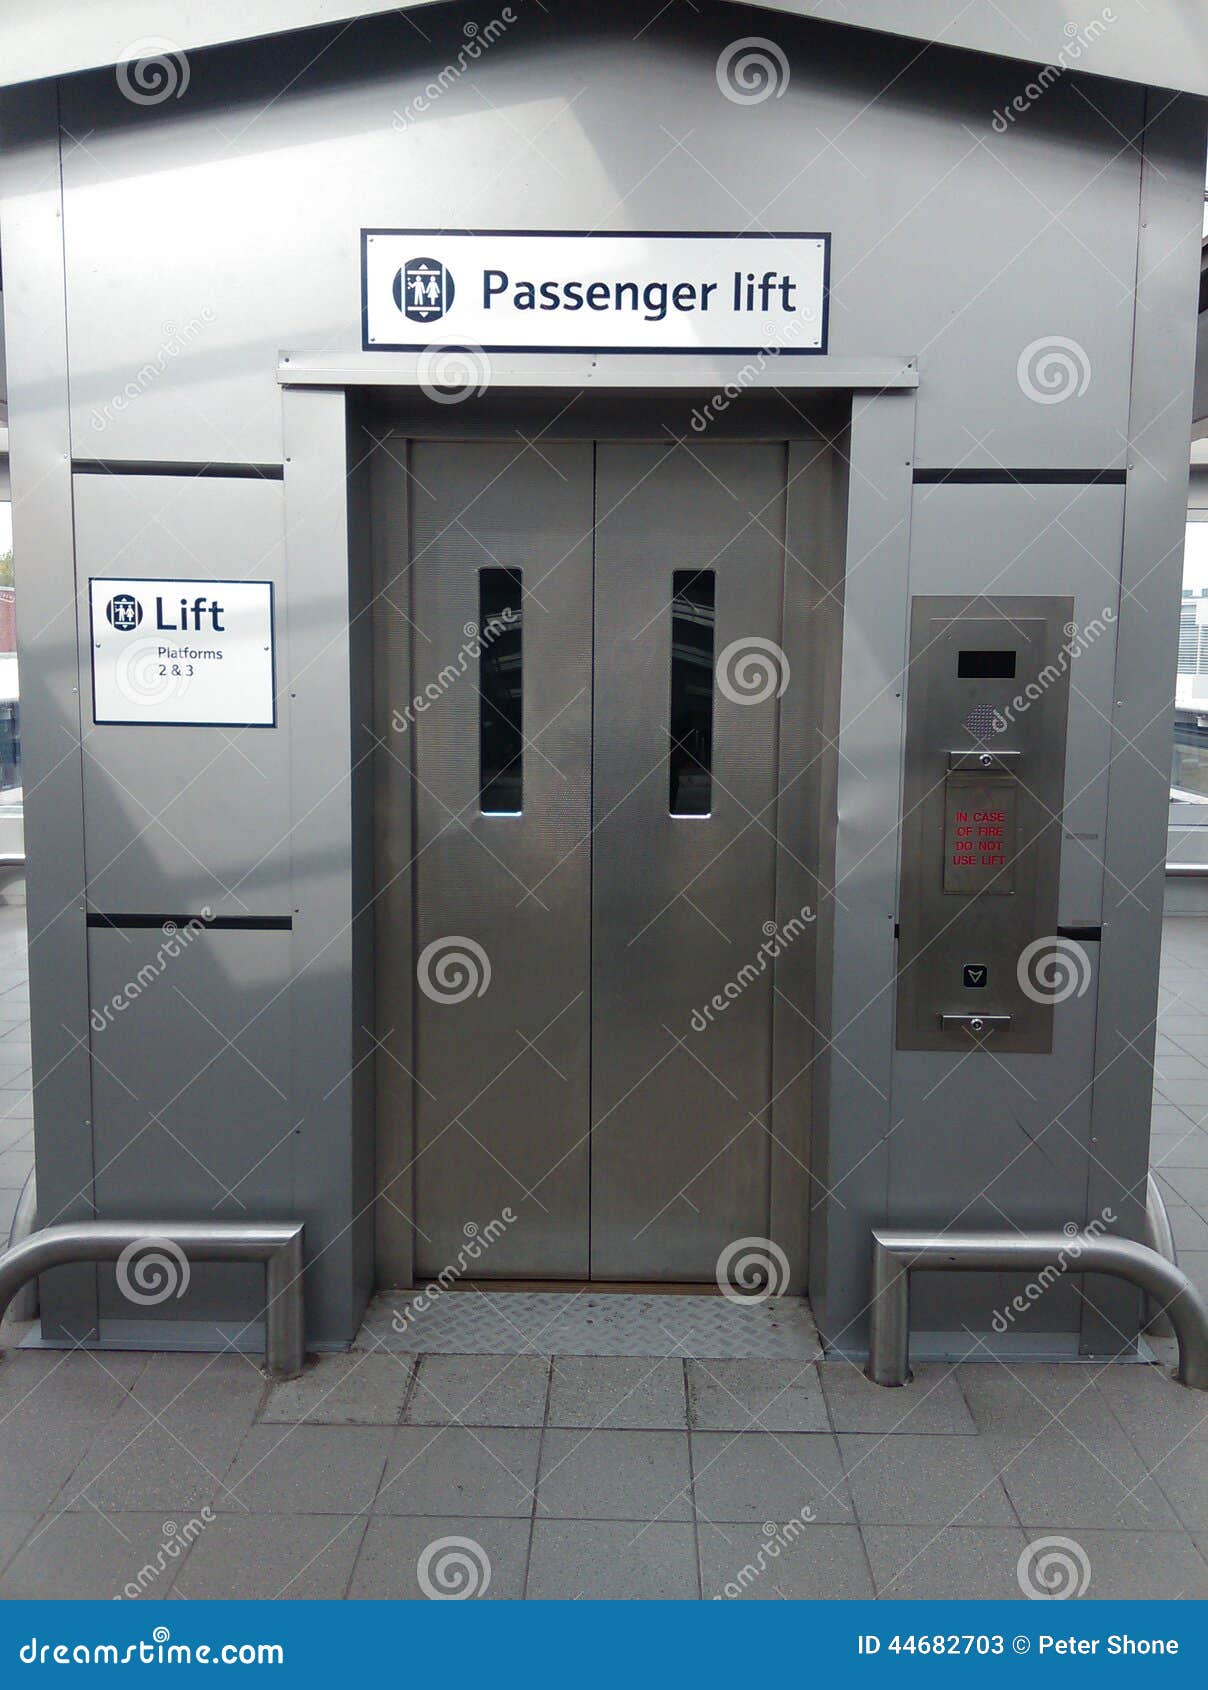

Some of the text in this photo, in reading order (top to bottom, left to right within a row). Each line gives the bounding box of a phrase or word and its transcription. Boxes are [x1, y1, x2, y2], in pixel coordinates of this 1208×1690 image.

[483, 269, 797, 321] Passenger lift
[156, 597, 225, 632] Lift
[157, 646, 223, 660] Platforms
[158, 664, 194, 677] 2 & 3
[955, 811, 1005, 822] IN CASE
[956, 826, 1003, 837] OF FIRE
[955, 841, 1004, 852] DO NOT
[952, 855, 1006, 866] USE LIFT
